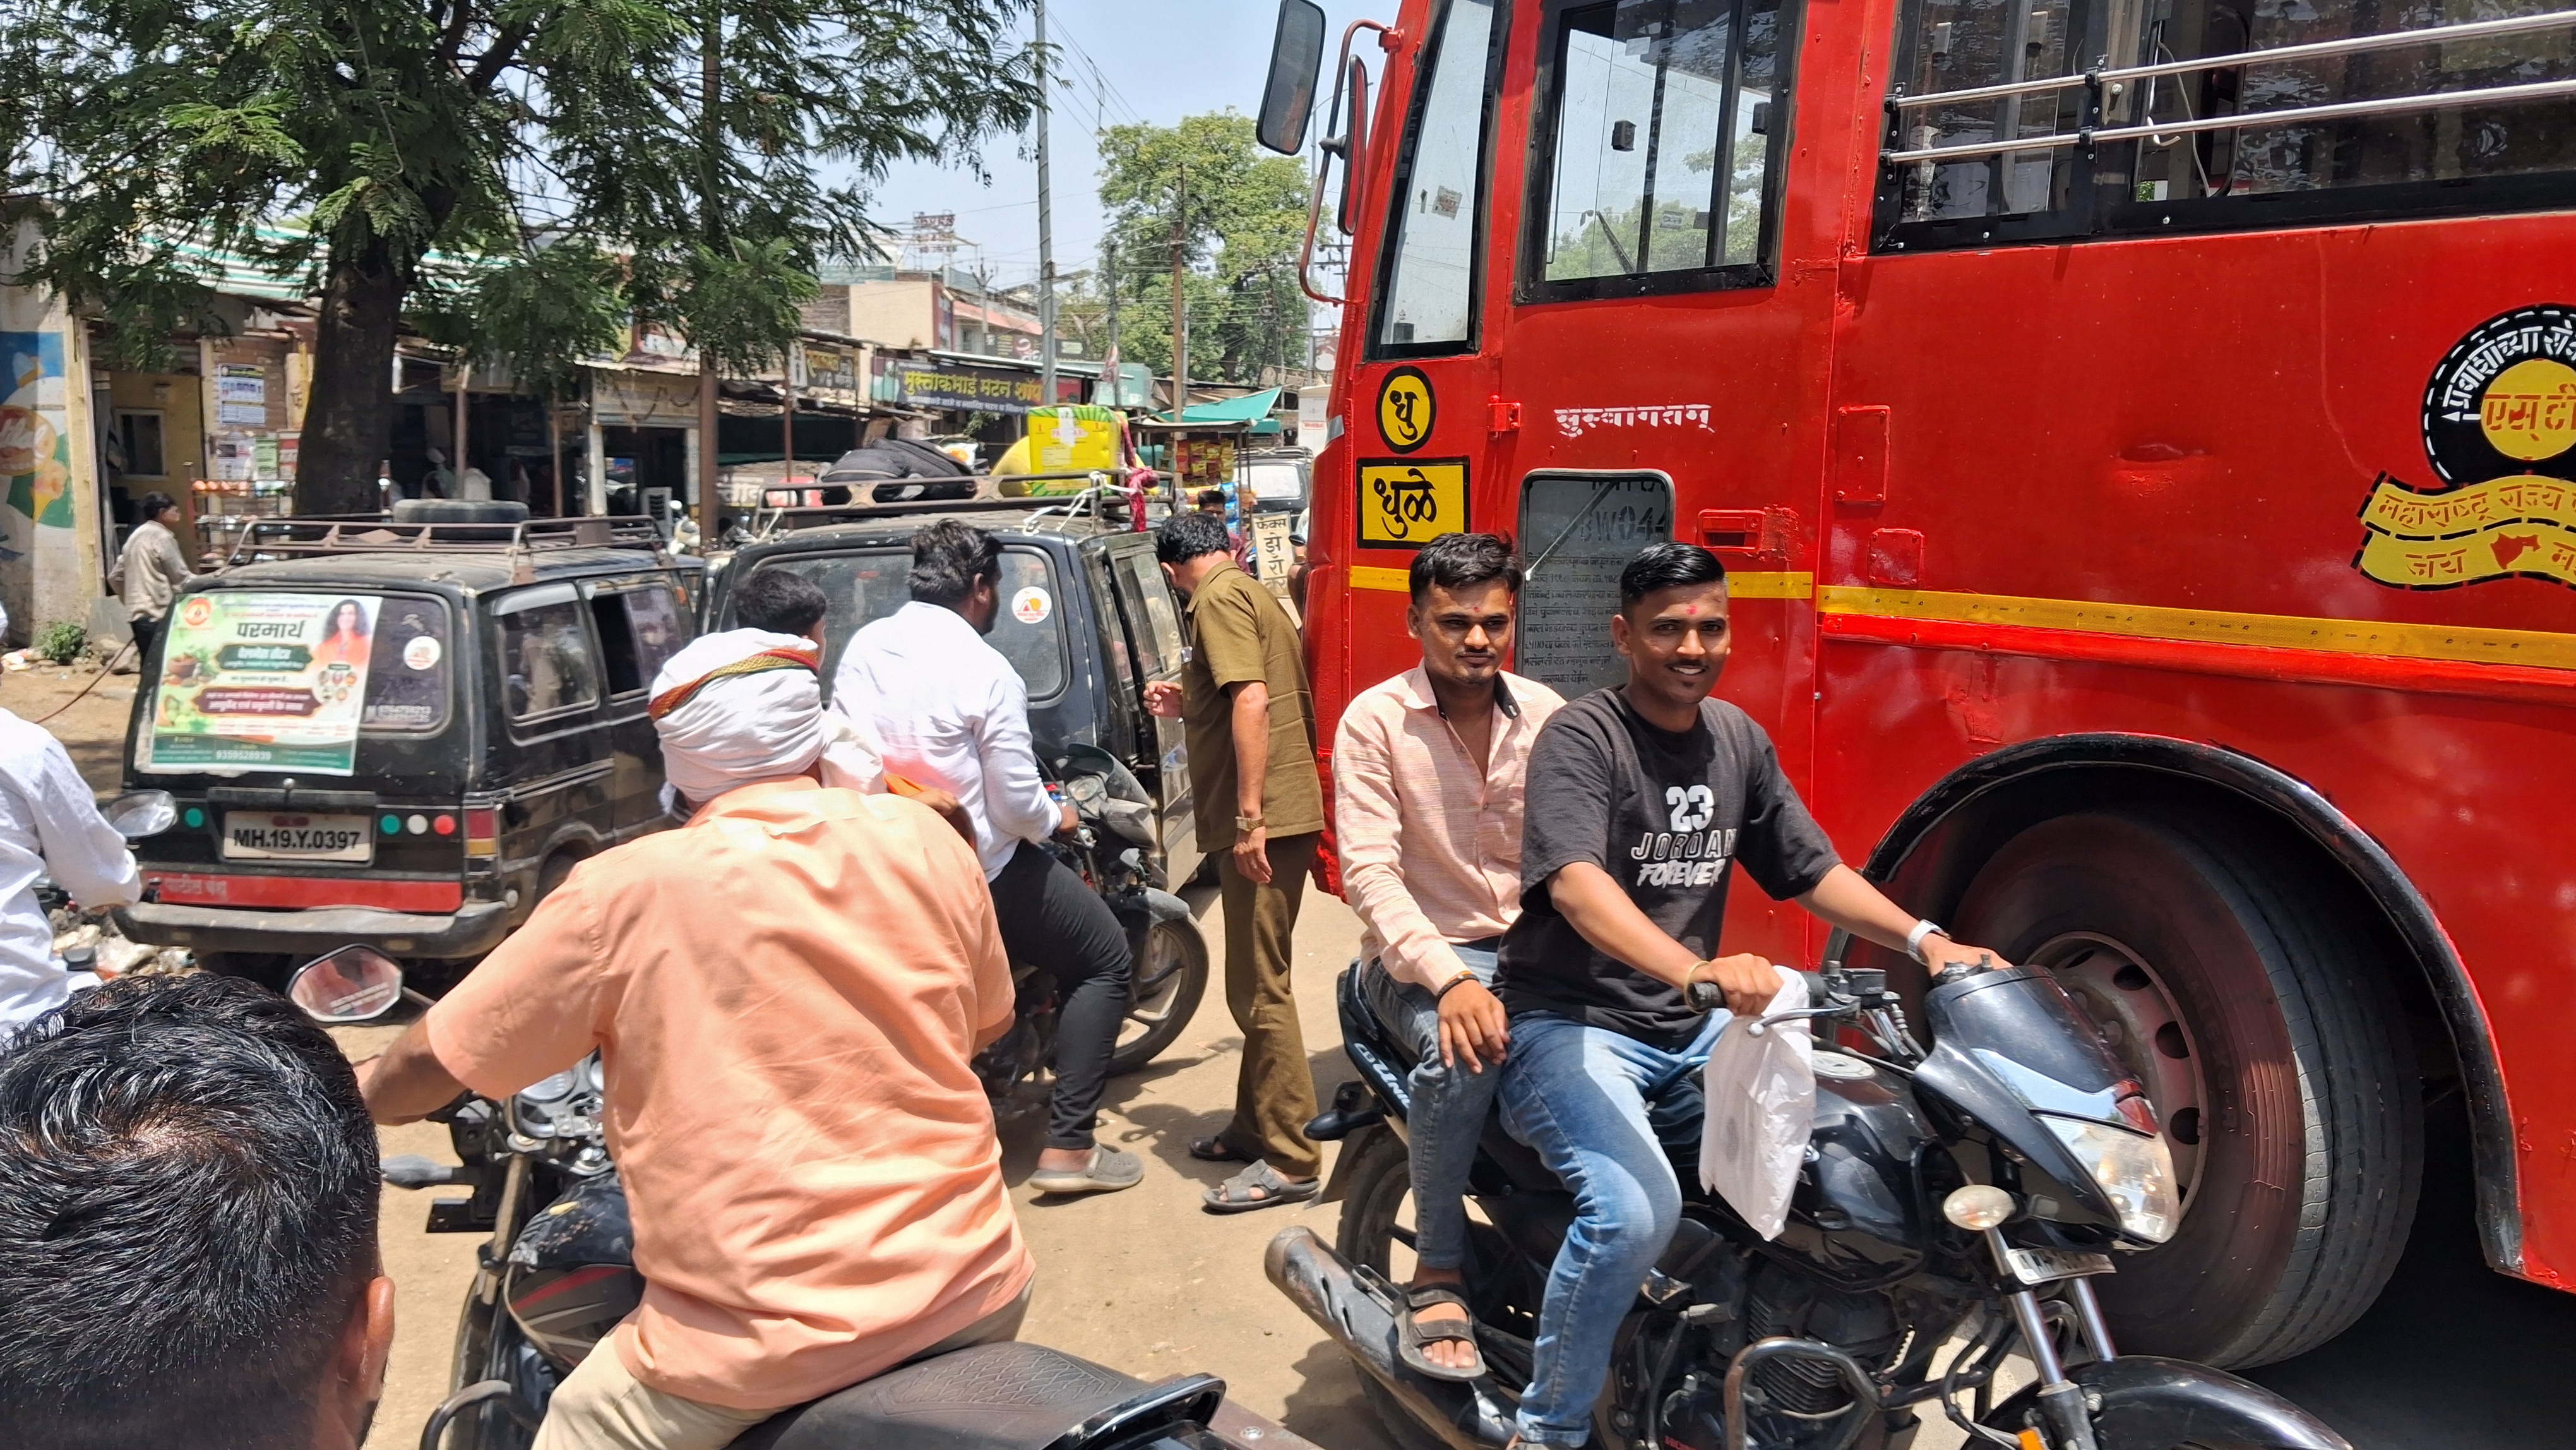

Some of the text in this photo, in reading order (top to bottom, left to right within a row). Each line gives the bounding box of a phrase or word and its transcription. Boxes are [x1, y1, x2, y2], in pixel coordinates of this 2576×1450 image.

[980, 378, 1011, 399] मटन
[1389, 389, 1419, 441] धु
[1553, 404, 1715, 438] सुस्वागतम्
[1373, 468, 1437, 538] धुळे
[2499, 483, 2565, 513] राज्य
[2405, 548, 2467, 578] जय
[236, 619, 306, 638] परमार्थ
[1665, 784, 1715, 832] 23
[233, 828, 361, 850] MH.19.Y.0397
[1630, 828, 1738, 861] JORDAN
[1636, 858, 1727, 889] FOREVER
